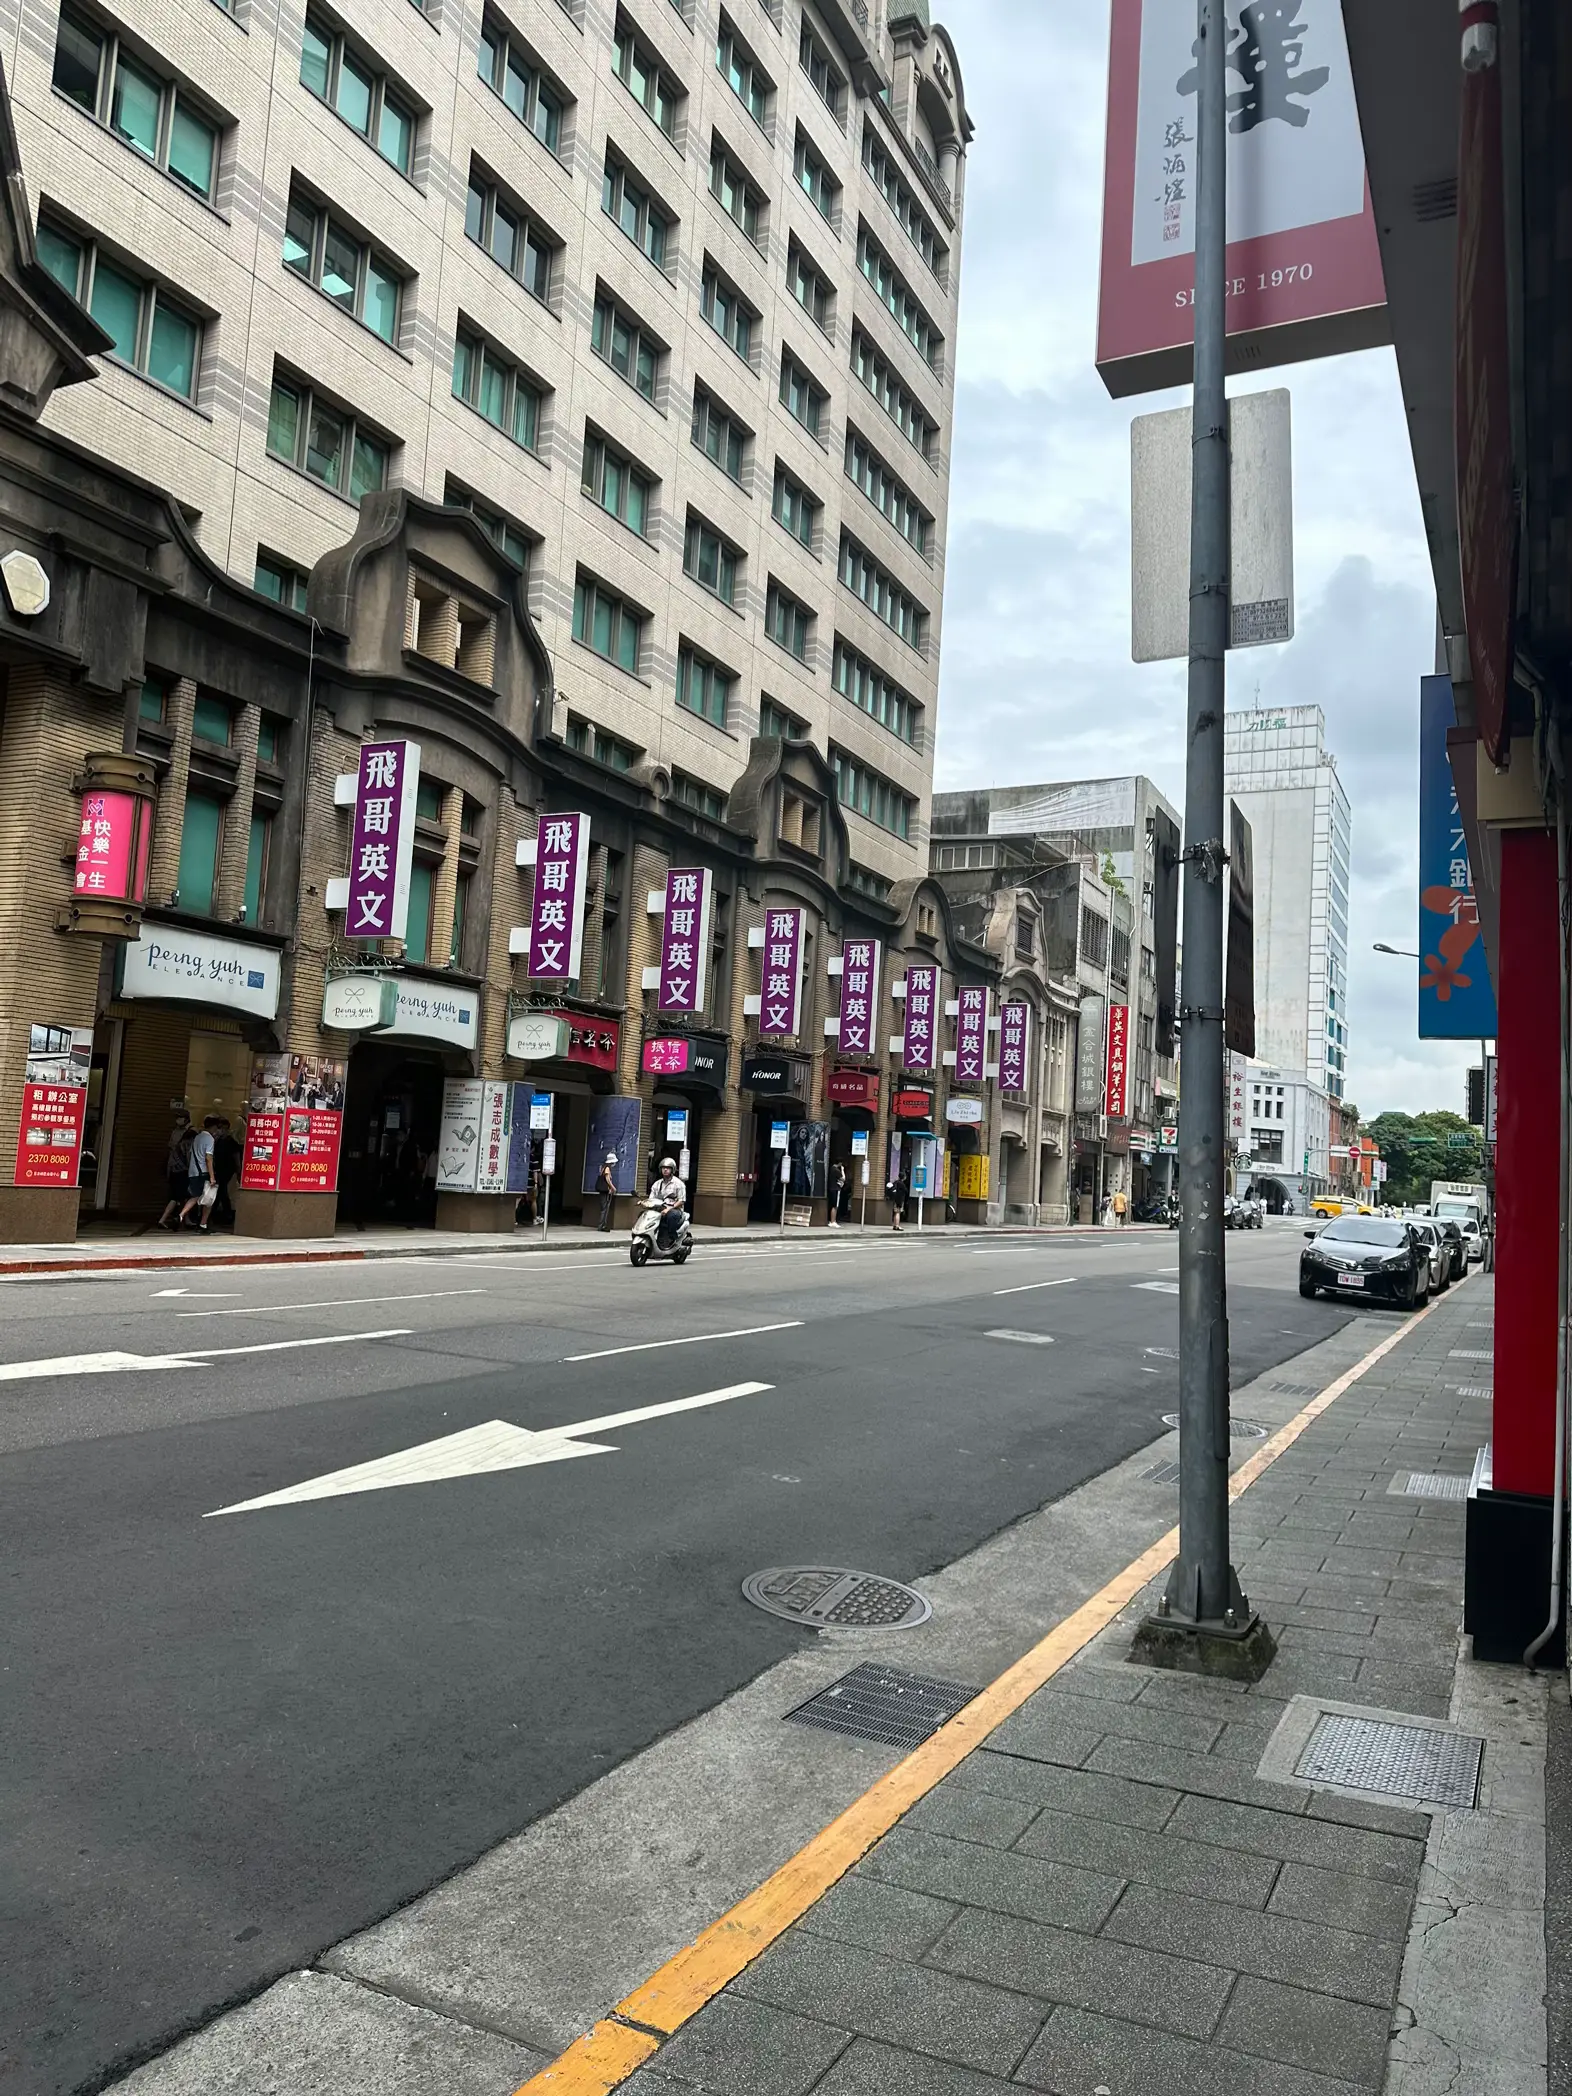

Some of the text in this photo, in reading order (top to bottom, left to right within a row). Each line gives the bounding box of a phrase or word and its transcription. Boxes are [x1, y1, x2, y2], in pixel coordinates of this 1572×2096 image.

[1257, 263, 1313, 291] 1970
[76, 819, 93, 888] 基金會
[88, 819, 112, 889] 快樂一生
[354, 750, 397, 928] 飛哥英文
[536, 821, 572, 970] 飛哥英文
[140, 942, 246, 979] perng yuh
[665, 874, 697, 1004] 飛哥英文
[765, 914, 794, 1028] 飛哥英文
[845, 945, 869, 1048] 飛哥英文
[431, 1000, 458, 1018] yuh
[908, 970, 931, 1064] 飛哥英文
[961, 990, 982, 1076] 飛哥英文
[649, 1056, 682, 1071] 茗茶
[651, 1041, 682, 1054] 振信
[752, 1069, 781, 1080] HONOR
[1003, 1007, 1022, 1087] 飛哥英文
[33, 1089, 79, 1104] 租 辦公室
[1232, 1071, 1244, 1128] 裕生銀樓
[28, 1153, 70, 1164] 2370 8080
[488, 1093, 504, 1177] 張志成數學
[246, 1163, 276, 1173] 2370 8080
[291, 1162, 328, 1173] 2370 8080
